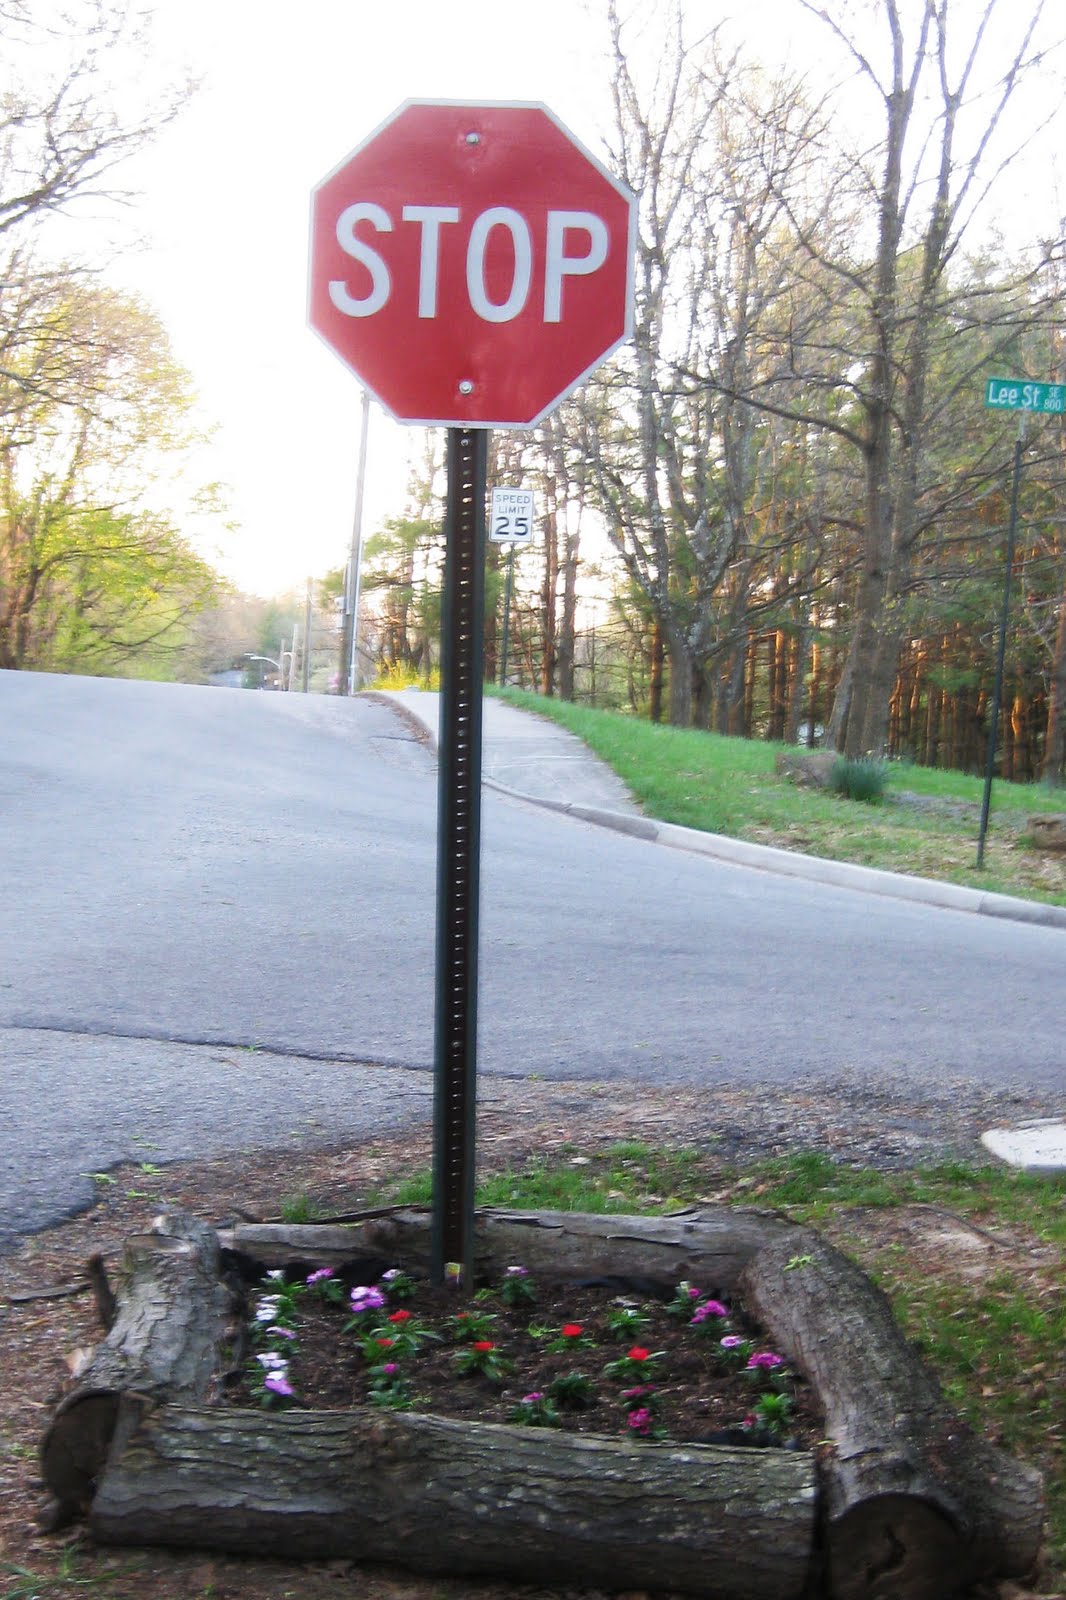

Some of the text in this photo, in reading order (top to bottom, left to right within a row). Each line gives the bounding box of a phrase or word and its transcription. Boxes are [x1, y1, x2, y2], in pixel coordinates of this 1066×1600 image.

[328, 202, 609, 323] STOP
[988, 382, 1040, 407] Lee St
[1044, 399, 1061, 410] 800
[496, 495, 531, 504] SPEED
[499, 506, 526, 514] LIMIT
[495, 516, 529, 536] 25
